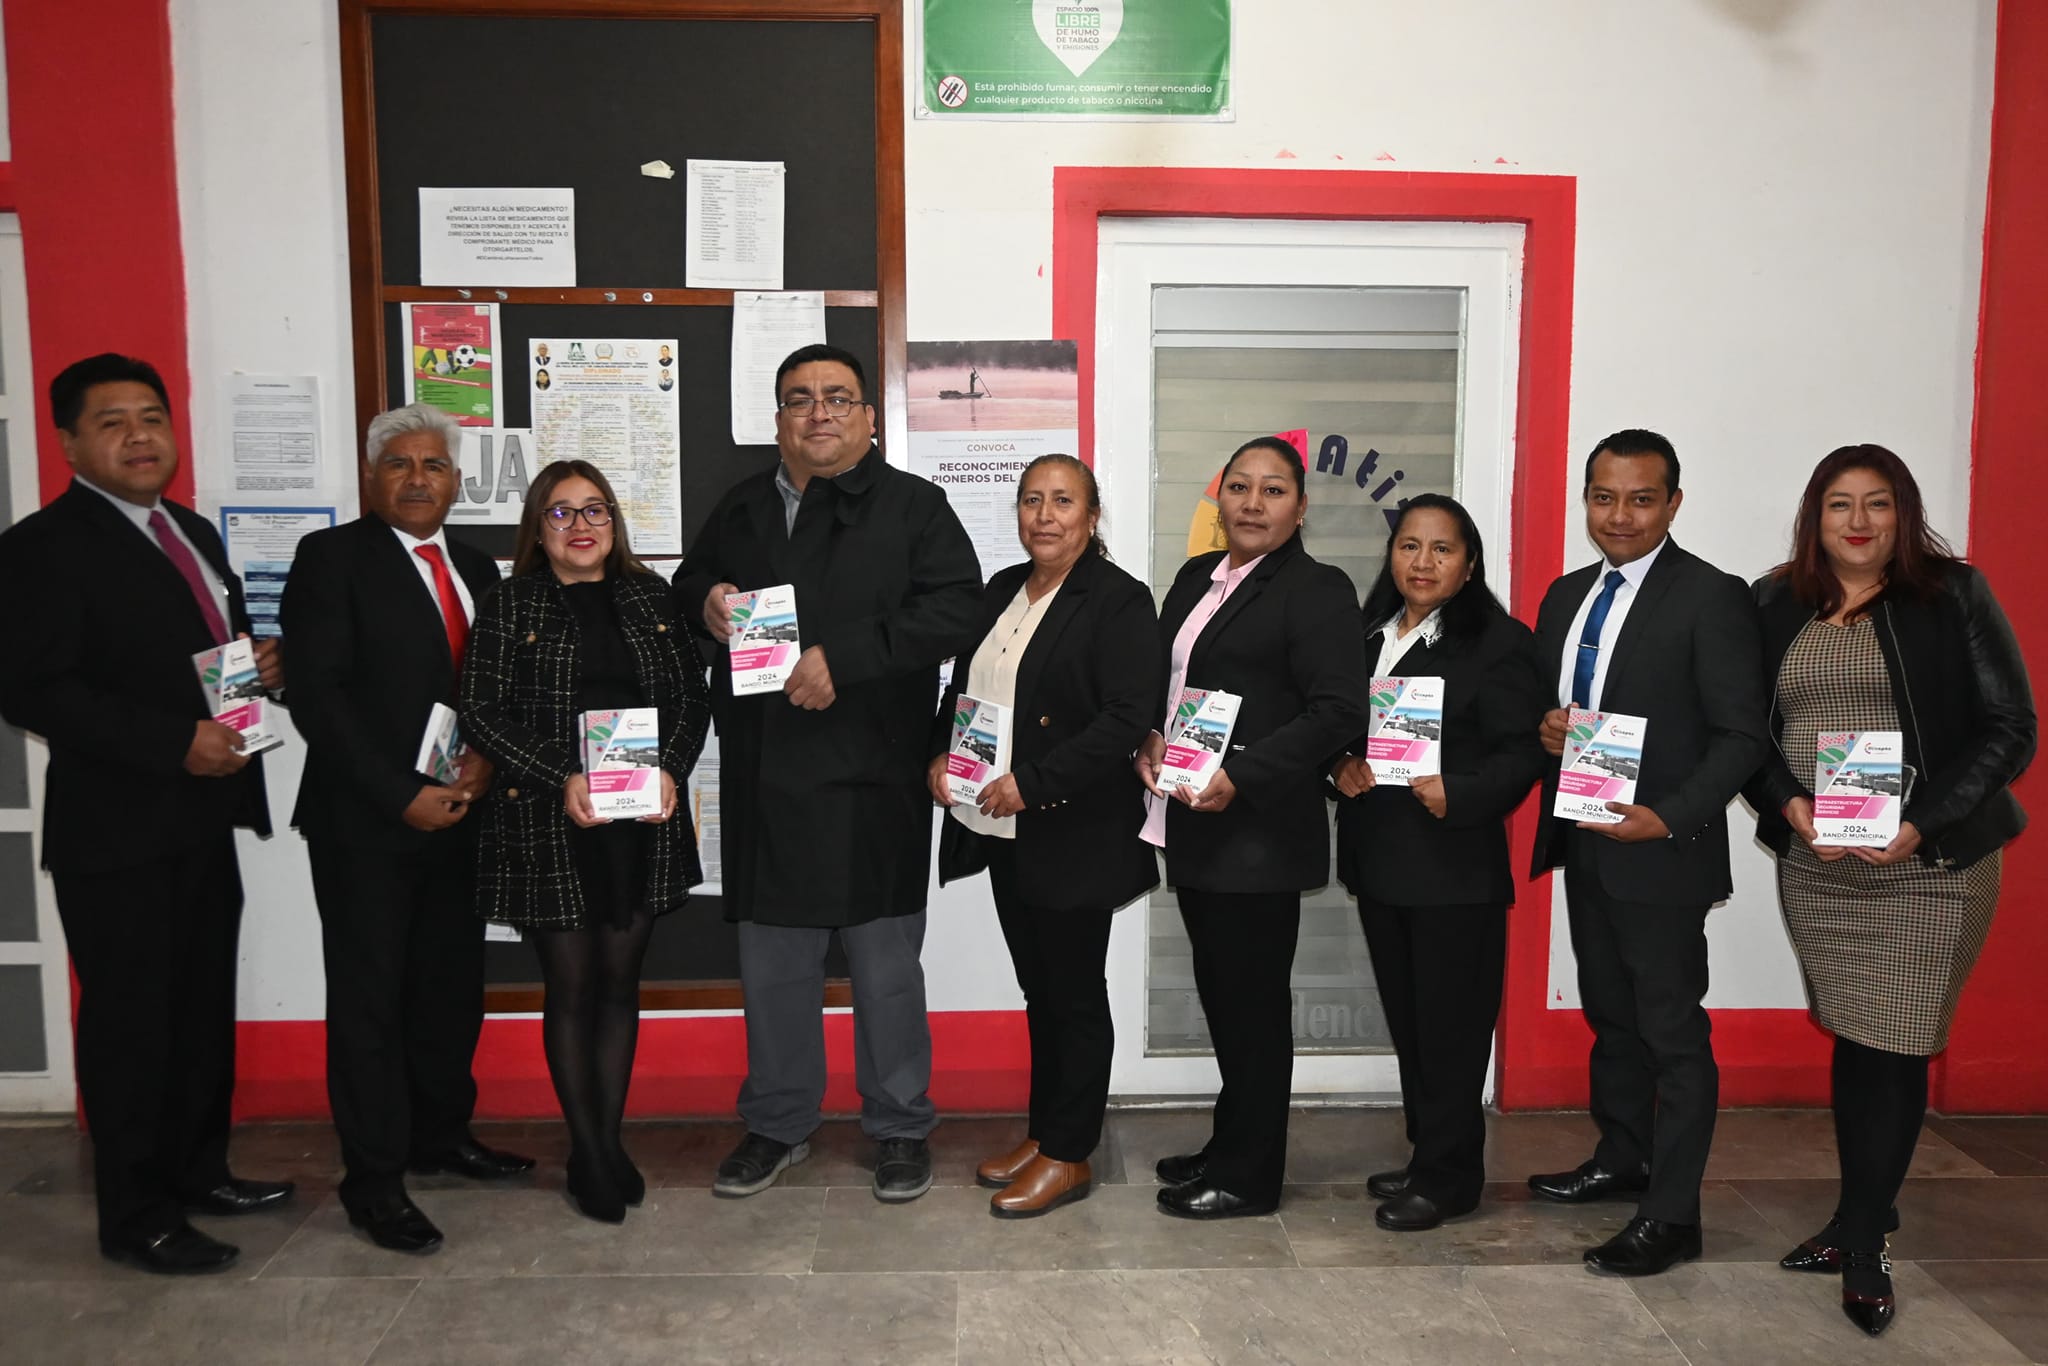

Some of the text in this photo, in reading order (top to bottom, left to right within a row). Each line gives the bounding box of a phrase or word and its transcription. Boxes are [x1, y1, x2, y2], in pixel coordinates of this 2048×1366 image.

[1056, 14, 1100, 27] LIBRE
[997, 82, 1044, 92] prohibido
[1045, 82, 1077, 93] fumar,
[1079, 83, 1123, 92] consumir
[1134, 84, 1160, 93] tener
[1161, 84, 1213, 93] encendido
[974, 95, 1019, 105] cualquier
[1021, 95, 1066, 105] producto
[1067, 95, 1080, 104] de
[1082, 96, 1113, 105] tabaco
[1125, 96, 1163, 105] nicotina
[449, 206, 490, 214] ¿NECESITAS
[967, 443, 1016, 452] CONVOCA
[939, 461, 1034, 472] RECONOCIMIEN
[931, 474, 1016, 484] PIONEROS DEL
[758, 673, 777, 681] 2024
[1390, 767, 1411, 775] 2024
[1176, 774, 1191, 783] 2024
[961, 784, 975, 794] 2024
[1582, 802, 1604, 812] 2024
[1563, 807, 1620, 821] BANDO MUNICIPAL
[1843, 825, 1868, 833] 2024
[1849, 832, 1888, 840] MUNICIPAL
